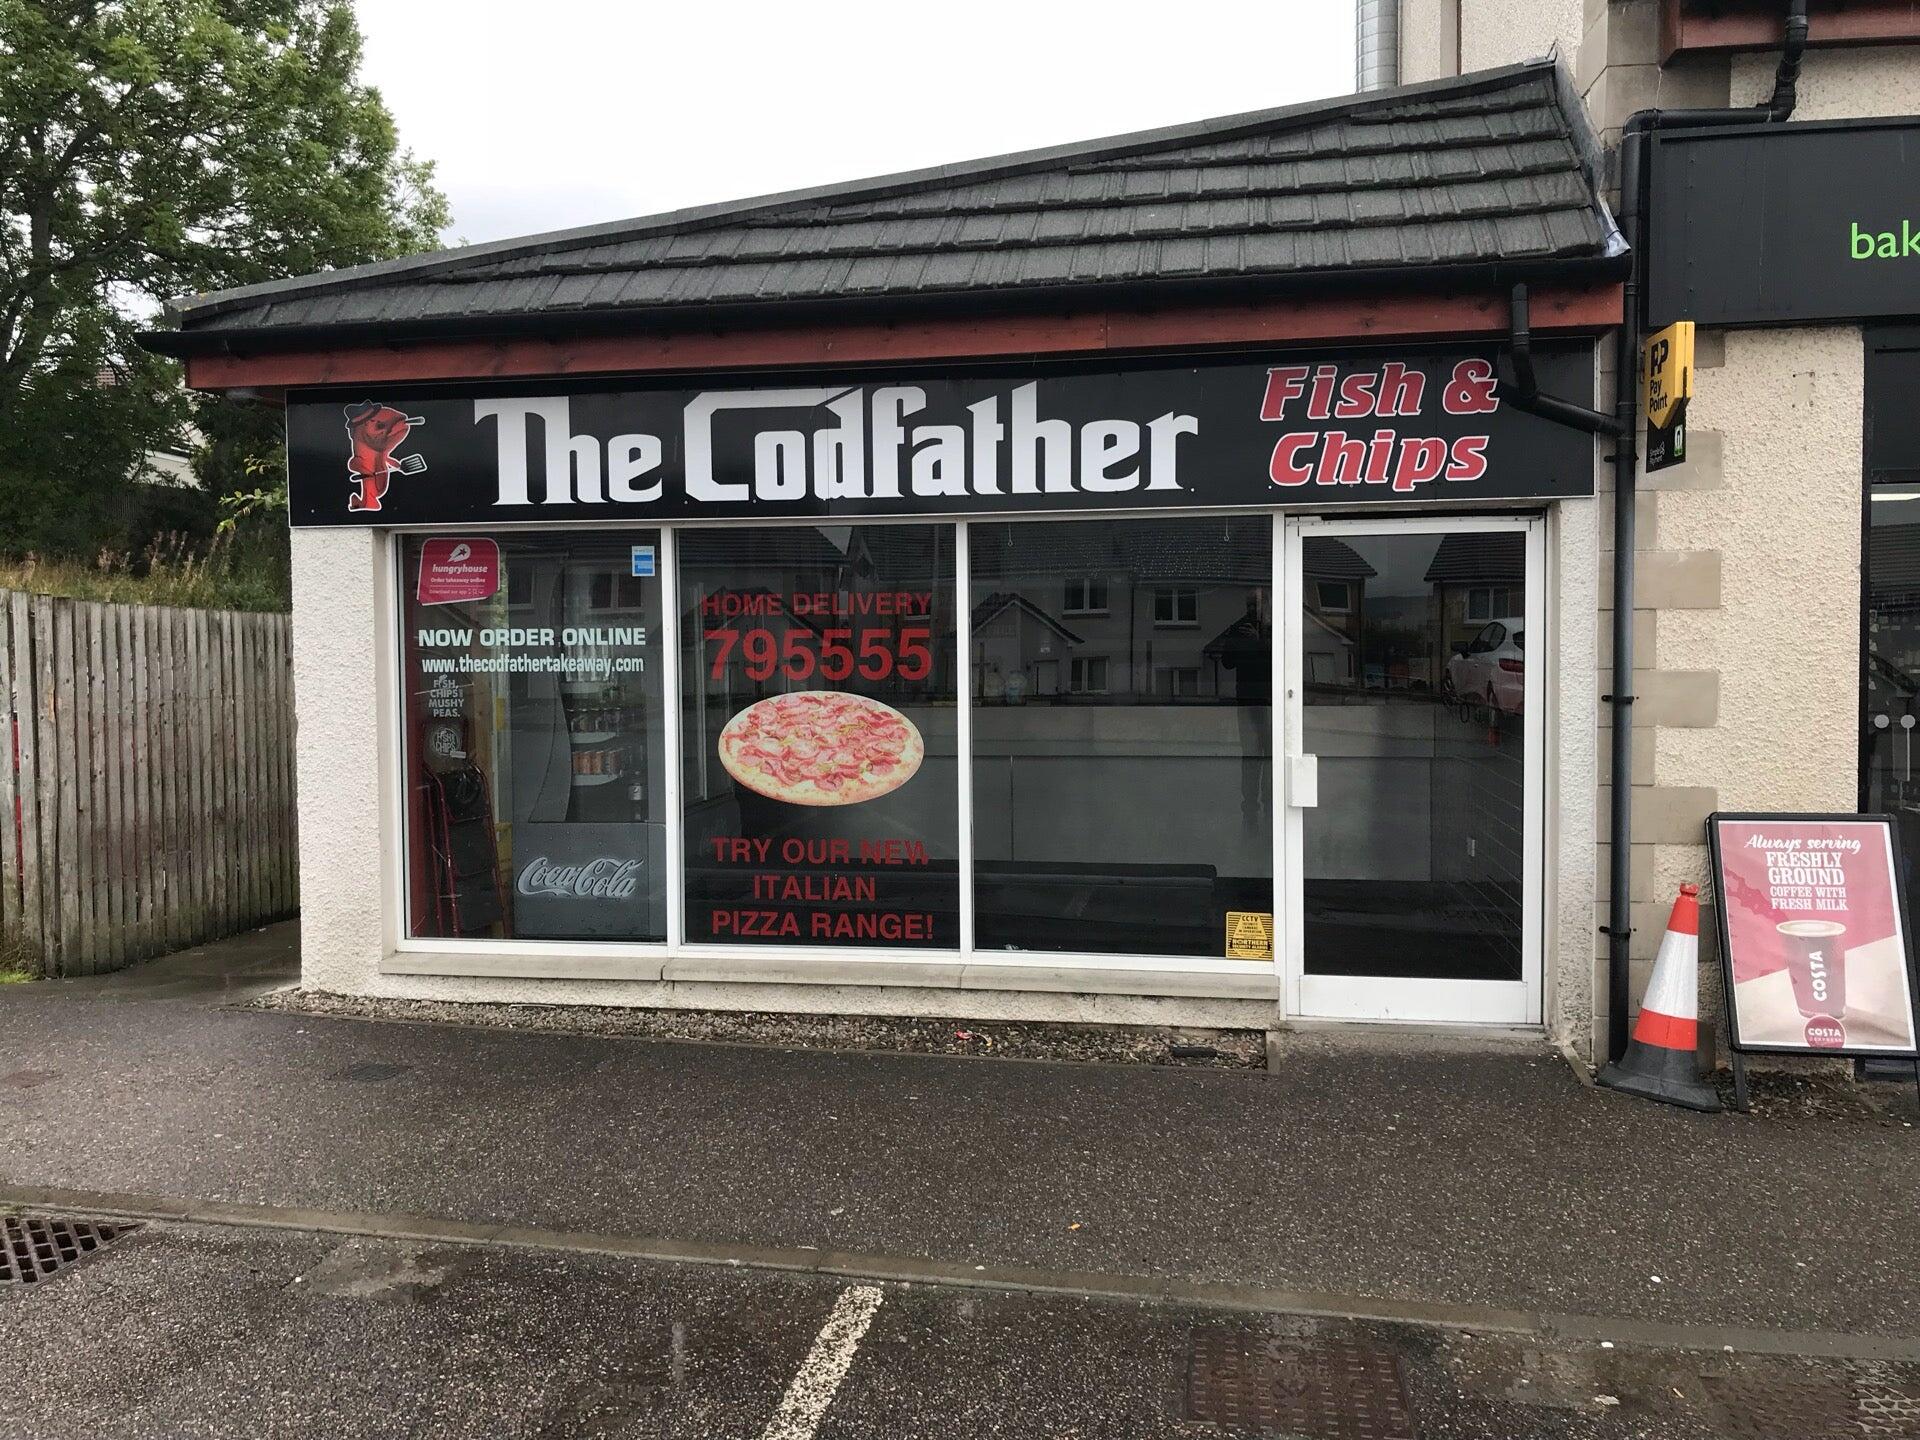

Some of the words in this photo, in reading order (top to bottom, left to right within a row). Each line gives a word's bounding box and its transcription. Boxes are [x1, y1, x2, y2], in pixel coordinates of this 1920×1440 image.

[1260, 362, 1427, 422] Fish
[1442, 358, 1501, 415] &
[1649, 379, 1662, 397] Pay
[1649, 392, 1668, 413] Point
[474, 395, 664, 505] The
[683, 380, 1199, 502] Codfather
[1268, 430, 1490, 493] Chips
[432, 563, 488, 574] hungryhouse
[701, 593, 783, 617] HOME
[793, 592, 932, 616] DELIVERY
[418, 628, 473, 647] NOW
[479, 628, 555, 647] ORDER
[561, 627, 646, 646] ONLINE
[705, 628, 932, 681] 795555
[421, 653, 644, 677] www.thecodfathertakeaway.com
[428, 699, 464, 708] MUSHY
[430, 689, 459, 698] CHIPS
[433, 709, 460, 717] PEAS.
[711, 837, 772, 863] TRY
[782, 838, 851, 864] OUR
[860, 839, 930, 865] NEW
[1744, 834, 1801, 853] Always
[1807, 834, 1861, 854] serving
[1765, 851, 1842, 868] FRESHLY
[1767, 868, 1845, 886] GROUND
[753, 874, 877, 901] ITALIAN
[1769, 886, 1813, 898] COFFEE
[1815, 887, 1847, 898] WITH
[1771, 898, 1813, 910] FRESH
[1815, 899, 1849, 911] MILK
[711, 910, 801, 937] PIZZA
[811, 912, 934, 940] RANGE!
[1808, 950, 1828, 1001] COSTA
[1808, 1027, 1842, 1037] COSTA
